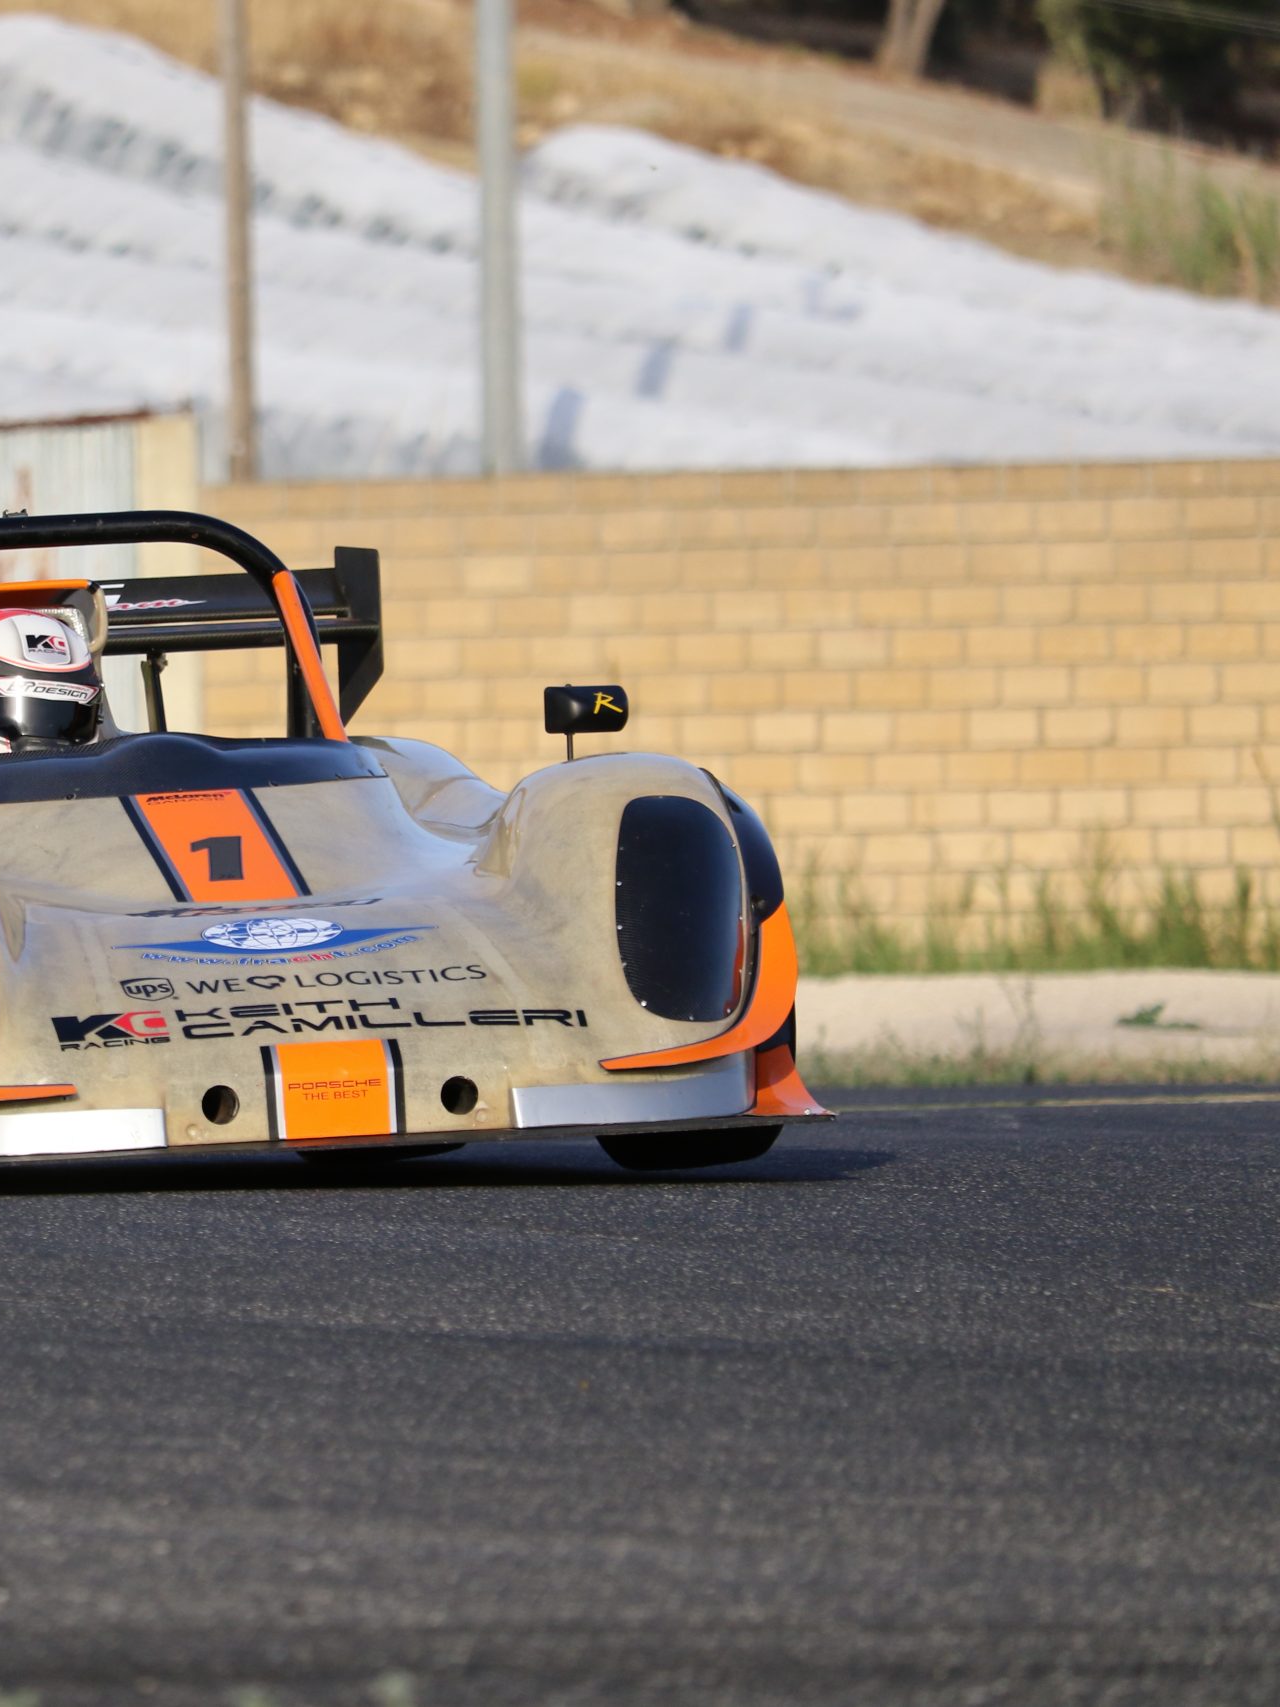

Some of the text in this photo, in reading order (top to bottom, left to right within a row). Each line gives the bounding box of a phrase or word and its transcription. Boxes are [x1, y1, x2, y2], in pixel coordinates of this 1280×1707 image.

[26, 634, 67, 650] KC
[593, 691, 624, 715] R
[190, 835, 244, 882] 1
[141, 934, 419, 965] www.fracht.com
[125, 964, 488, 998] ups WE LOGISTICS
[175, 997, 401, 1022] KEITH
[51, 1010, 170, 1043] KC
[182, 1009, 588, 1040] CAMILLERI
[60, 1036, 170, 1052] RACING
[287, 1078, 382, 1092] PORSCHE
[303, 1089, 369, 1101] THE BEST
